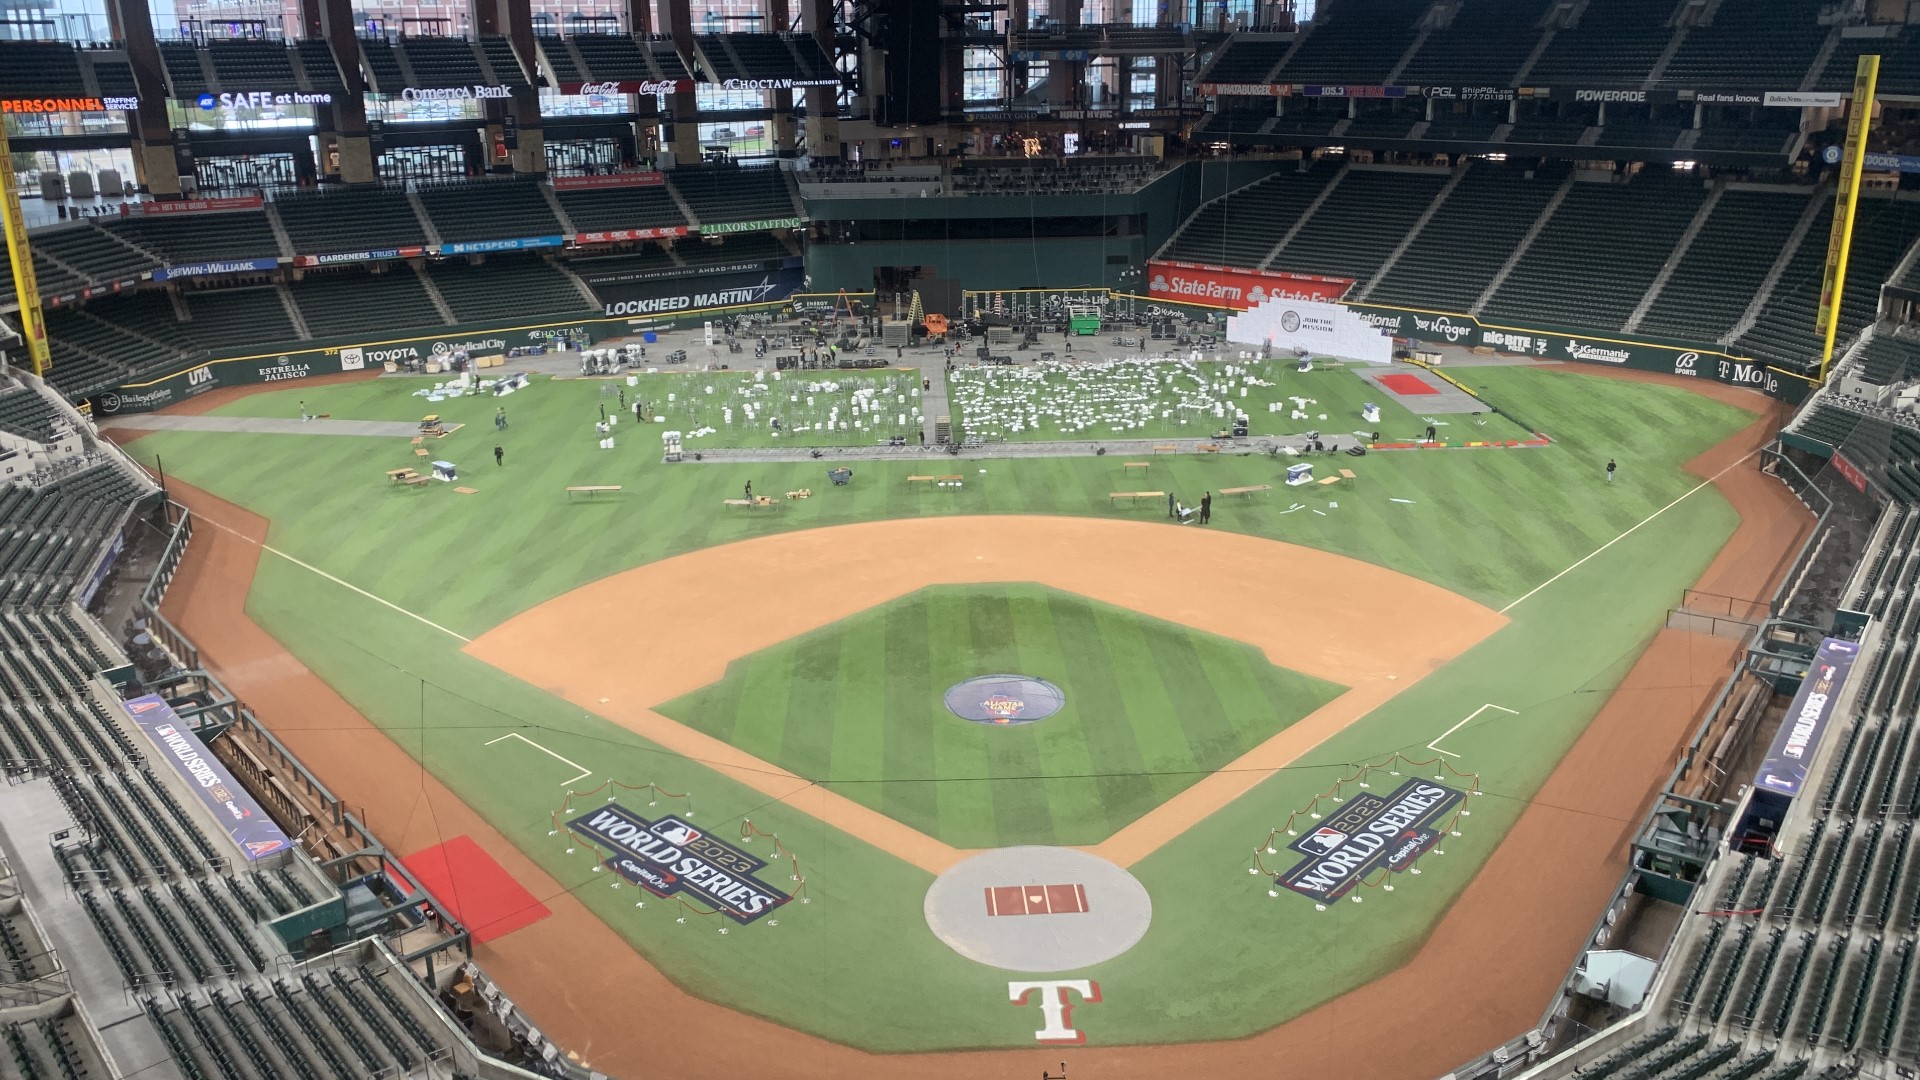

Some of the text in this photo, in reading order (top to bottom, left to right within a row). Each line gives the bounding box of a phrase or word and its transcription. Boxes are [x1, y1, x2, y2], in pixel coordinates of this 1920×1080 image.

[580, 82, 620, 96] Coca-Cola
[640, 80, 677, 95] Coca-Cola
[730, 78, 792, 90] CHOCTAW
[1216, 84, 1271, 95] WHATABURGER
[474, 84, 512, 99] Bank
[1321, 87, 1344, 96] 105.3
[1430, 87, 1457, 97] PGL
[1575, 90, 1646, 102] POWERADE
[1697, 94, 1760, 102] Real fans know.
[2, 97, 138, 113] PERSONNEL STAFFING
[105, 102, 139, 110] SERVICES
[220, 92, 273, 110] SAFE
[276, 96, 291, 104] at
[294, 92, 331, 104] home
[975, 112, 1037, 120] PRIORITY GOLD
[162, 203, 173, 211] HIT
[710, 217, 799, 233] LUXOR STAFFING
[465, 240, 517, 251] NETSPEND
[320, 251, 370, 262] GARDENERS
[372, 250, 397, 258] TRUST
[698, 263, 759, 274] AHEAD-READY
[605, 289, 753, 316] LOCKHEED MARTIN
[534, 327, 583, 339] CHOCTAW
[1302, 324, 1333, 332] MISSION
[1430, 316, 1471, 342] Kroger
[449, 338, 506, 351] Medical City
[1504, 334, 1531, 348] BITE
[366, 347, 418, 362] TOYOTA
[1584, 345, 1630, 359] Germania
[188, 366, 213, 385] UTA
[259, 363, 310, 376] ESTRELLA
[264, 370, 307, 382] JALISCO
[1675, 367, 1697, 376] SPORTS
[163, 732, 197, 765] WORLD
[184, 757, 221, 788] SERIES
[1333, 798, 1384, 832] 2023
[1294, 784, 1446, 892] WORLD SERIES
[588, 810, 775, 914] WORLD SERIES
[690, 840, 751, 873] 2023
[1008, 979, 1103, 1045] T
